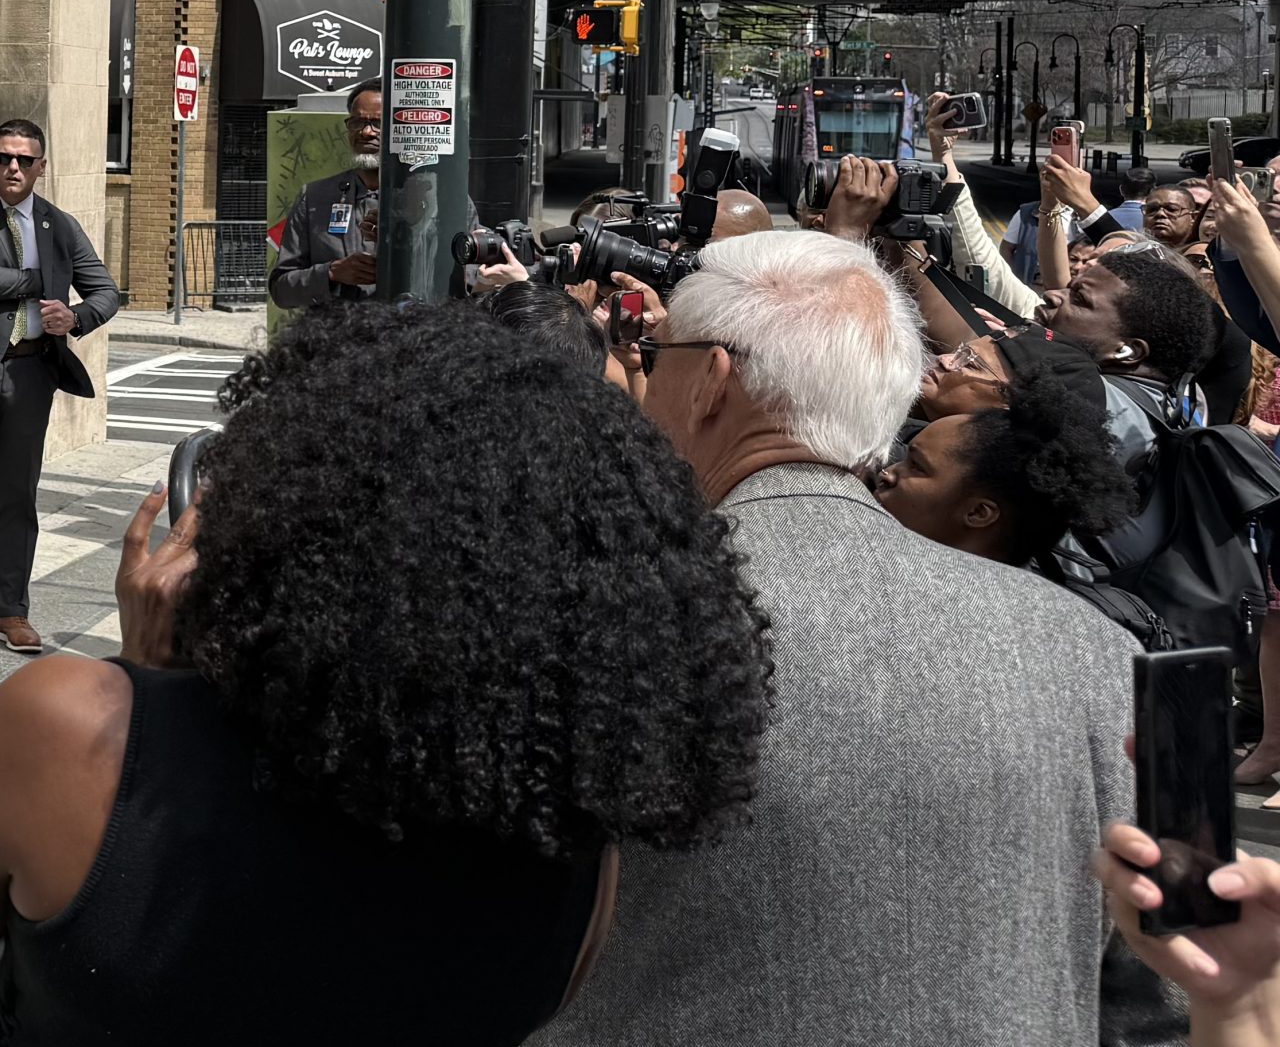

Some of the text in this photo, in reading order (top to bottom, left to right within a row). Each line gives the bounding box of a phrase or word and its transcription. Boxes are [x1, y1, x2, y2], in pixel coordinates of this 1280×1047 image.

[326, 40, 374, 65] Lounge
[180, 60, 195, 74] DO NOT
[403, 66, 442, 76] DANGER
[394, 81, 452, 90] HIGH VOLTAGE
[179, 92, 193, 105] ENTER
[404, 91, 440, 99] AUTHORIZED
[399, 98, 429, 106] PERSONNEL
[402, 111, 442, 121] PELIGRO
[393, 125, 451, 135] ALTO VOLTAJE
[392, 136, 423, 144] SOLAMENTE
[403, 144, 439, 152] AUTORIZADO
